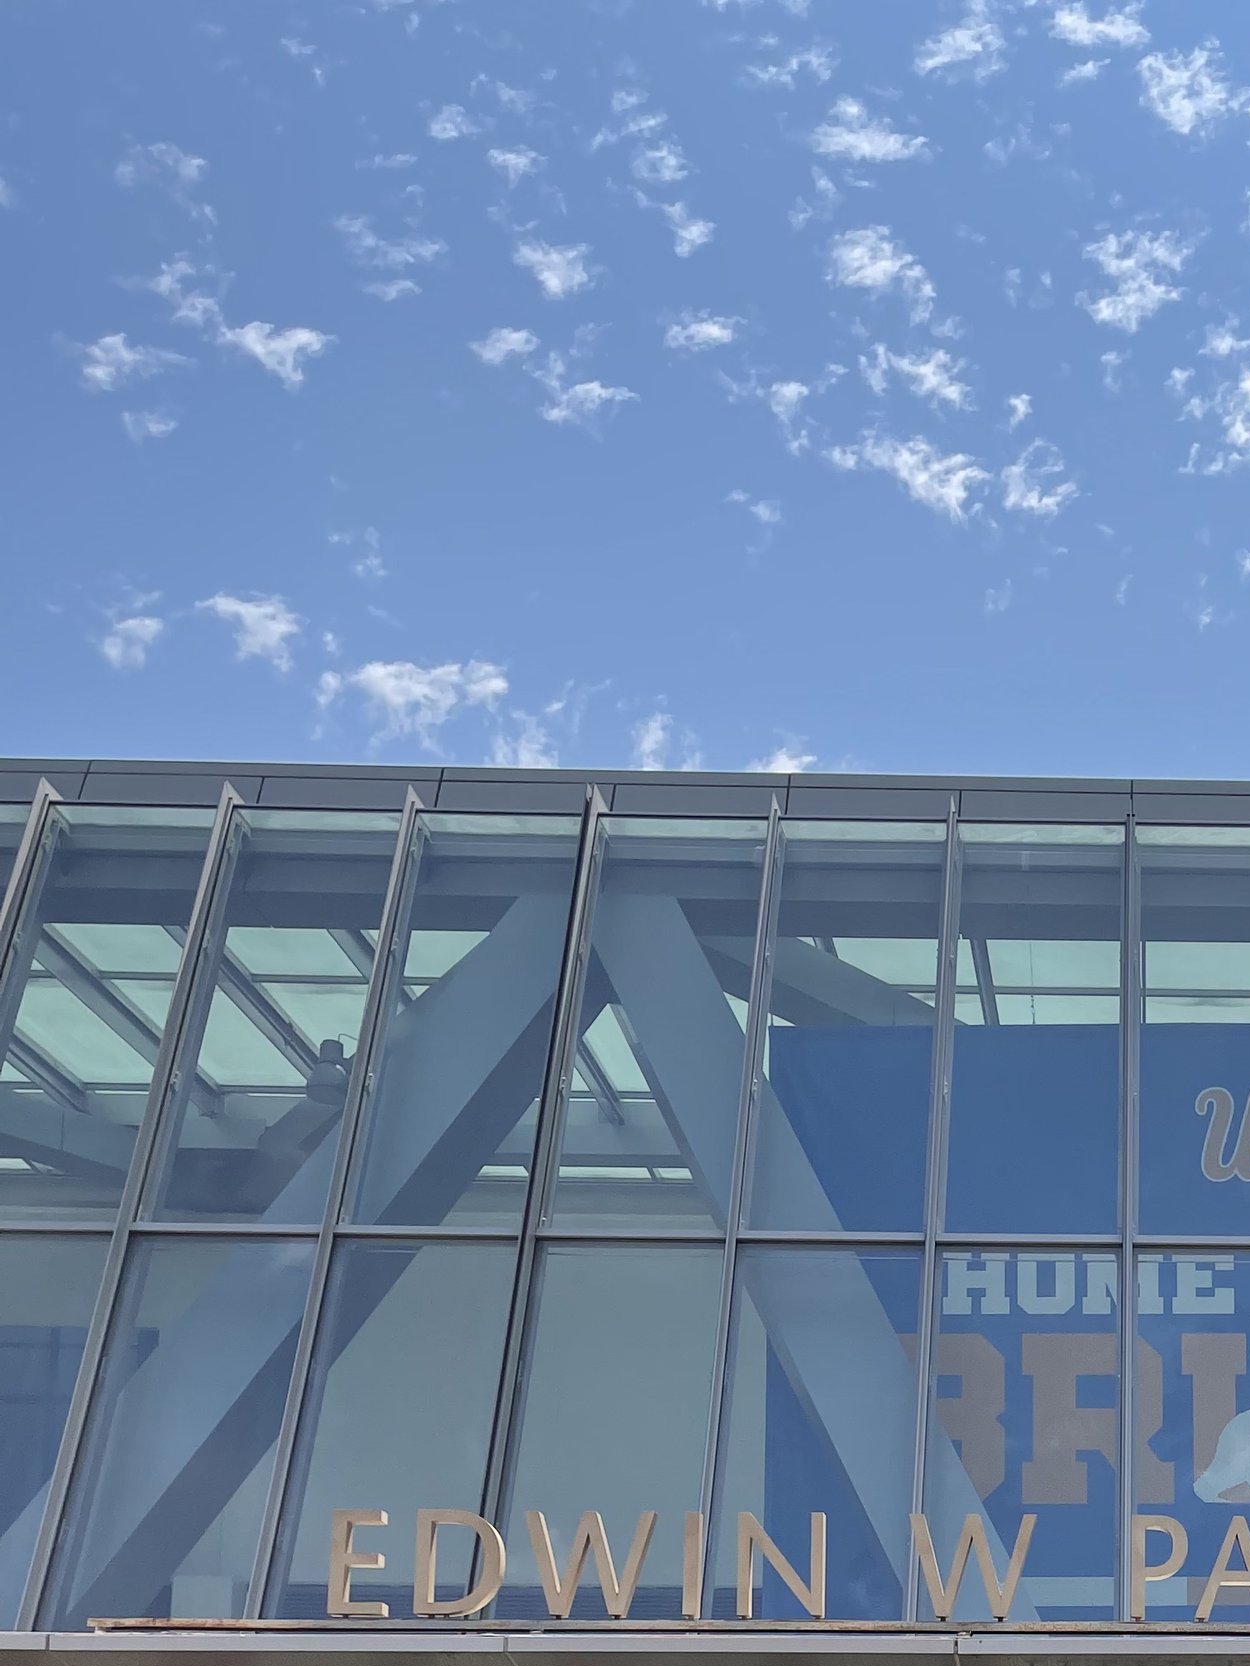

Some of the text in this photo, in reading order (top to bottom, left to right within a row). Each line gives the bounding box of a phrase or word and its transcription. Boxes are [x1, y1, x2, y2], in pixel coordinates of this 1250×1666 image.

[942, 1253, 1235, 1314] HOME
[327, 1508, 826, 1618] EDWIN
[909, 1511, 1037, 1621] W
